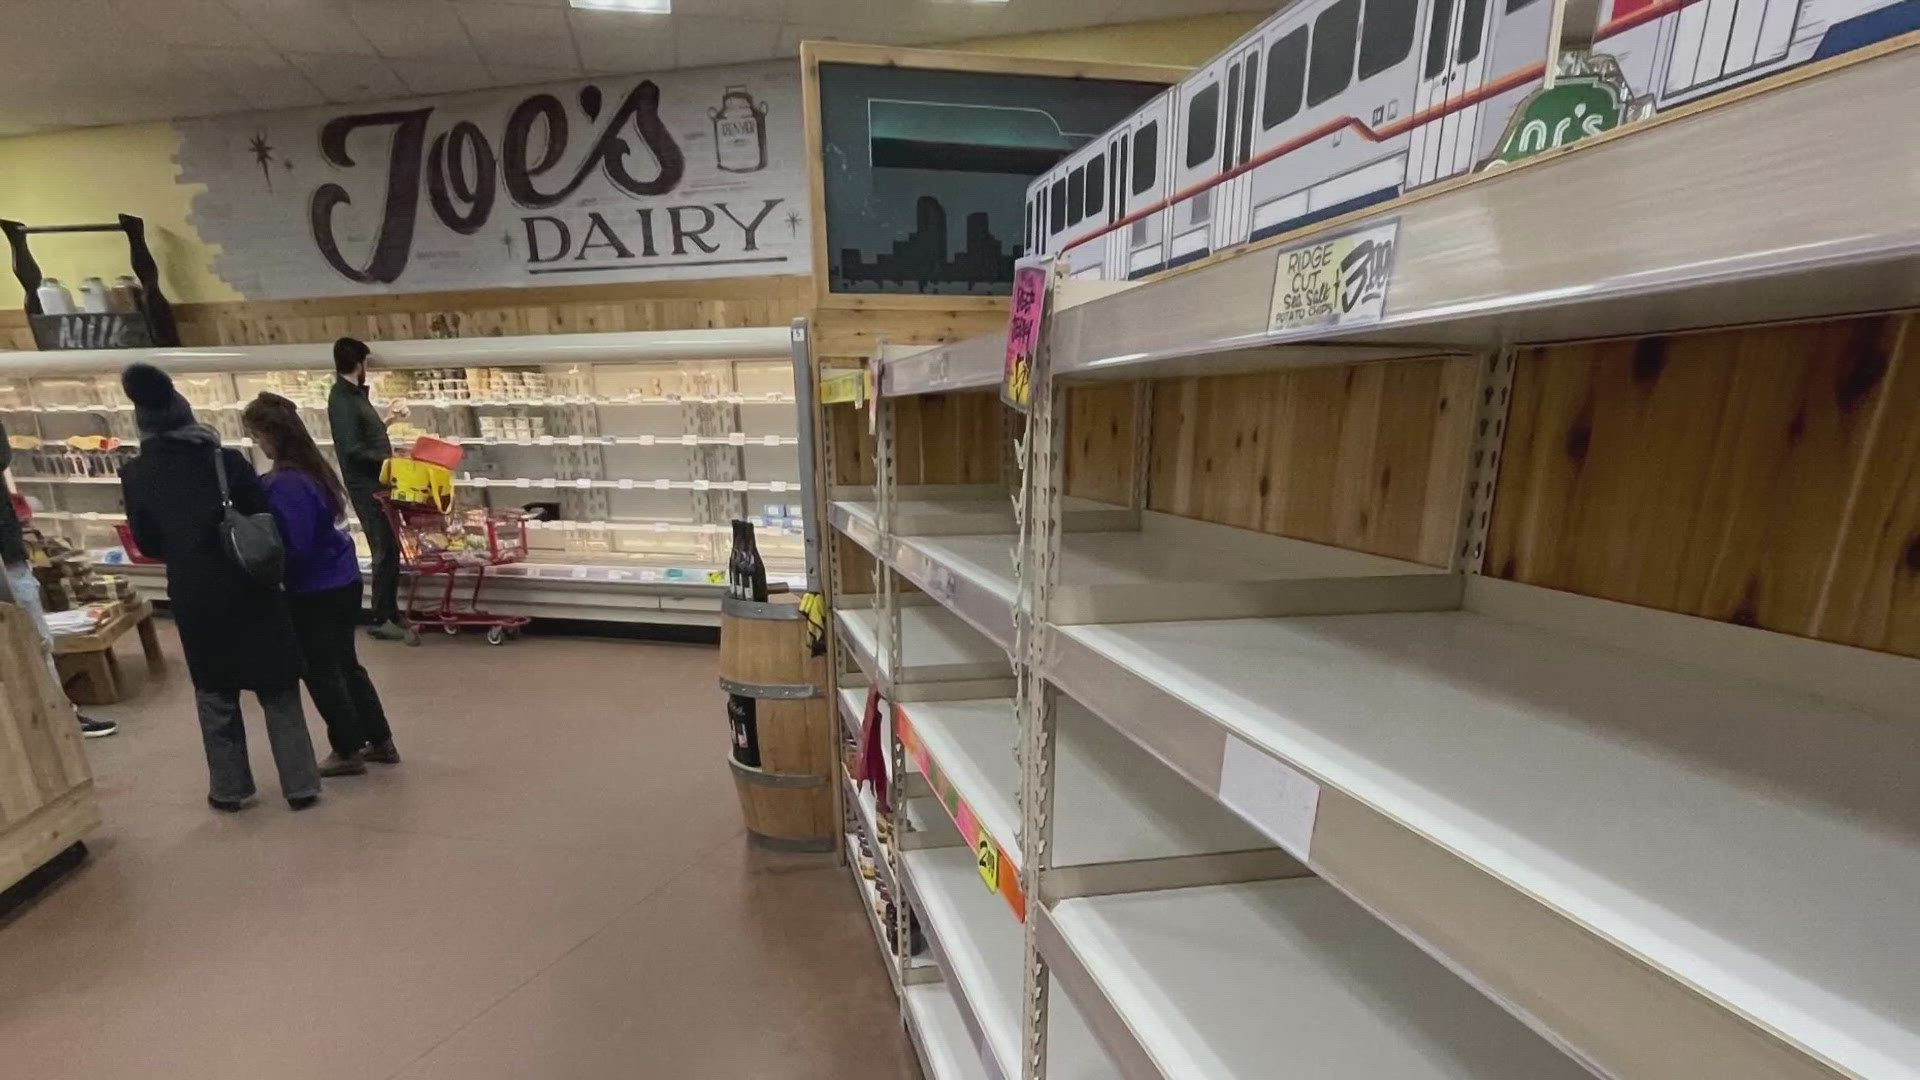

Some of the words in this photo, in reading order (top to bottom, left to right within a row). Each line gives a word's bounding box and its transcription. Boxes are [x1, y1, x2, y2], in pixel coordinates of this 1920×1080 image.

[312, 79, 685, 284] Joe's
[520, 198, 785, 262] DAIRY
[1288, 242, 1335, 274] RIDGE
[1292, 269, 1322, 293] CUT
